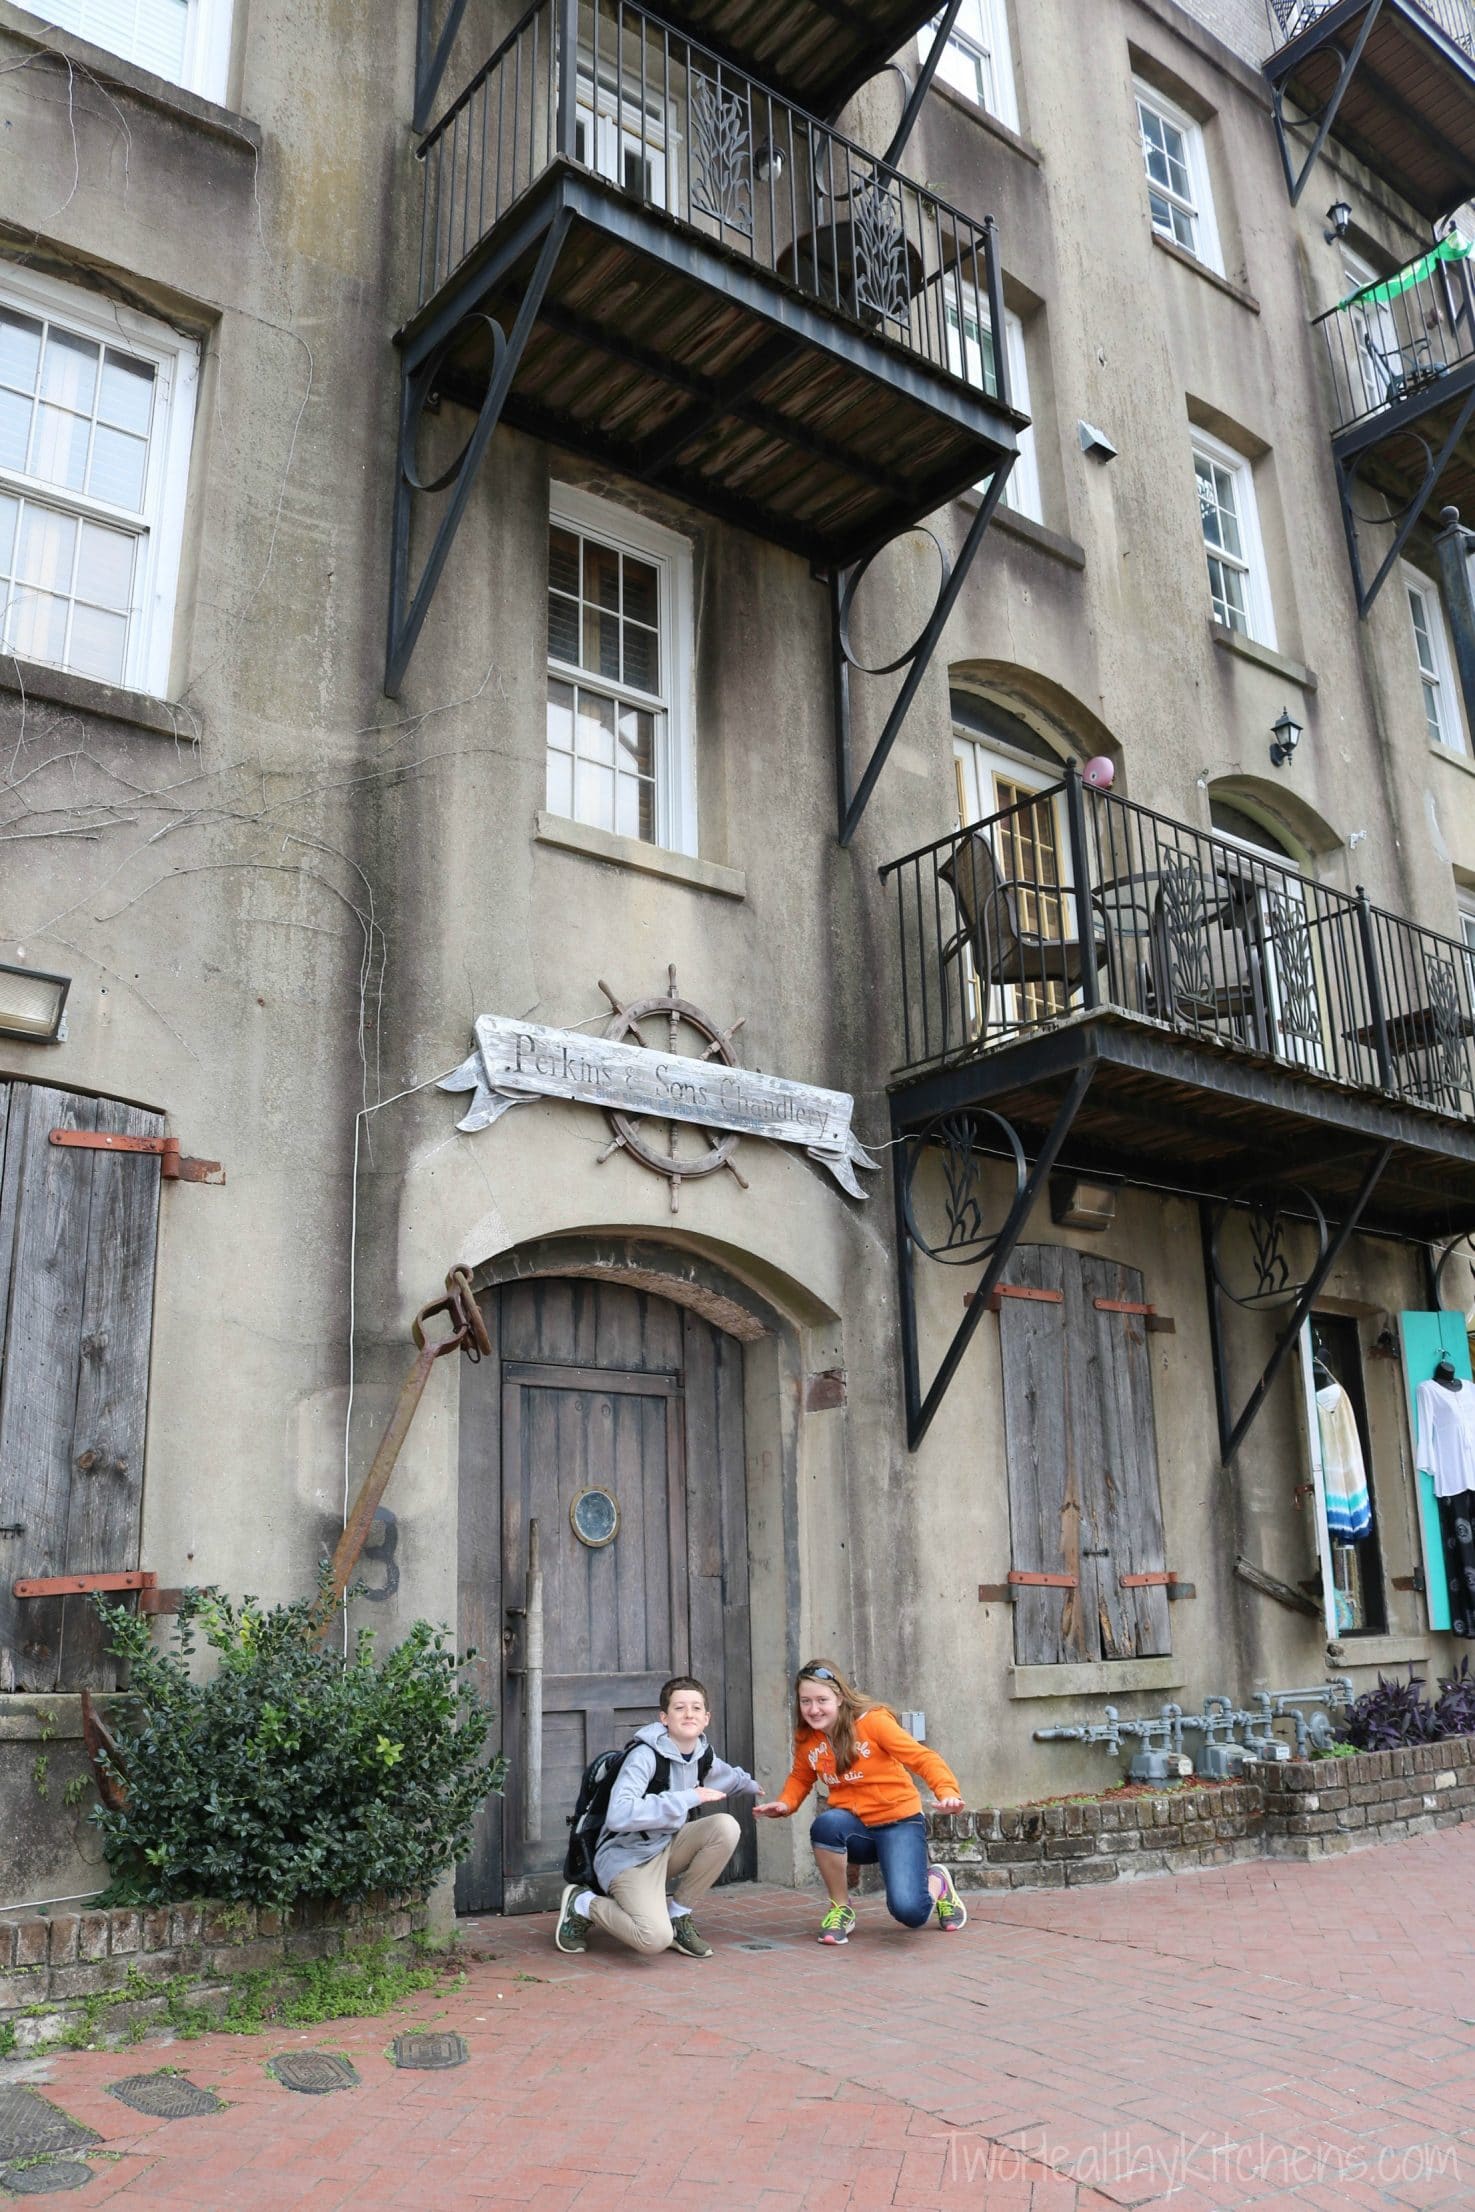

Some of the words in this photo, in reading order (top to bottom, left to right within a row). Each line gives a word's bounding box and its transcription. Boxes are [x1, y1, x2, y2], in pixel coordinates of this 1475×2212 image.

[512, 1032, 613, 1087] Perkins
[655, 1063, 708, 1106] Sons
[719, 1077, 829, 1140] Chandlery
